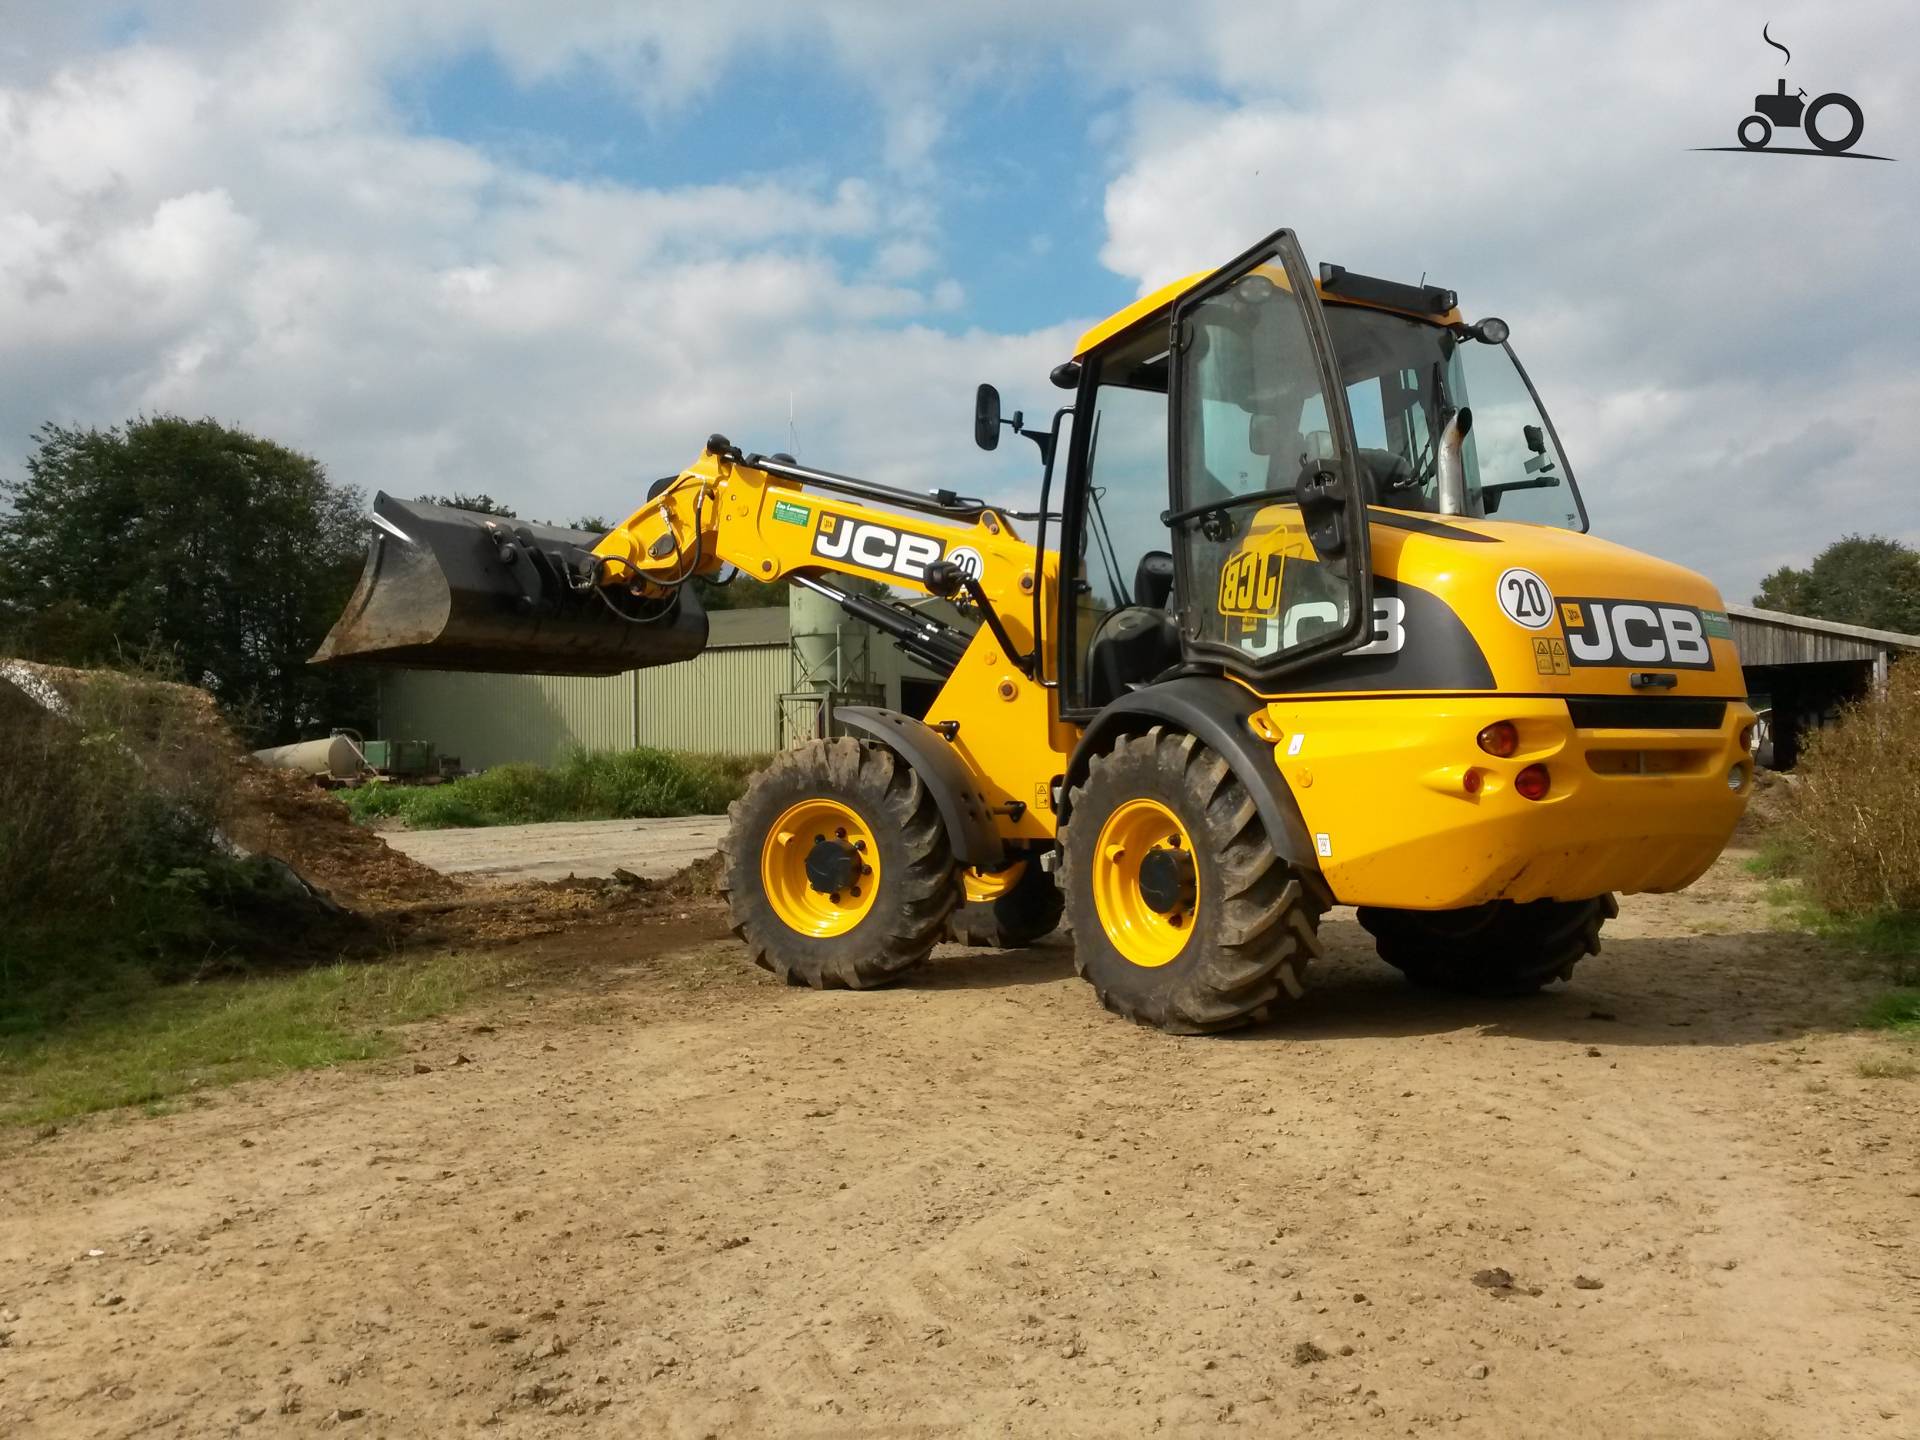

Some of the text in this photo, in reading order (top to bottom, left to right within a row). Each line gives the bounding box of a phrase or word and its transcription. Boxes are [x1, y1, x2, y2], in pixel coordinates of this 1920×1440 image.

[816, 519, 941, 579] JCB
[1508, 578, 1546, 617] 20
[1569, 604, 1709, 664] JCB
